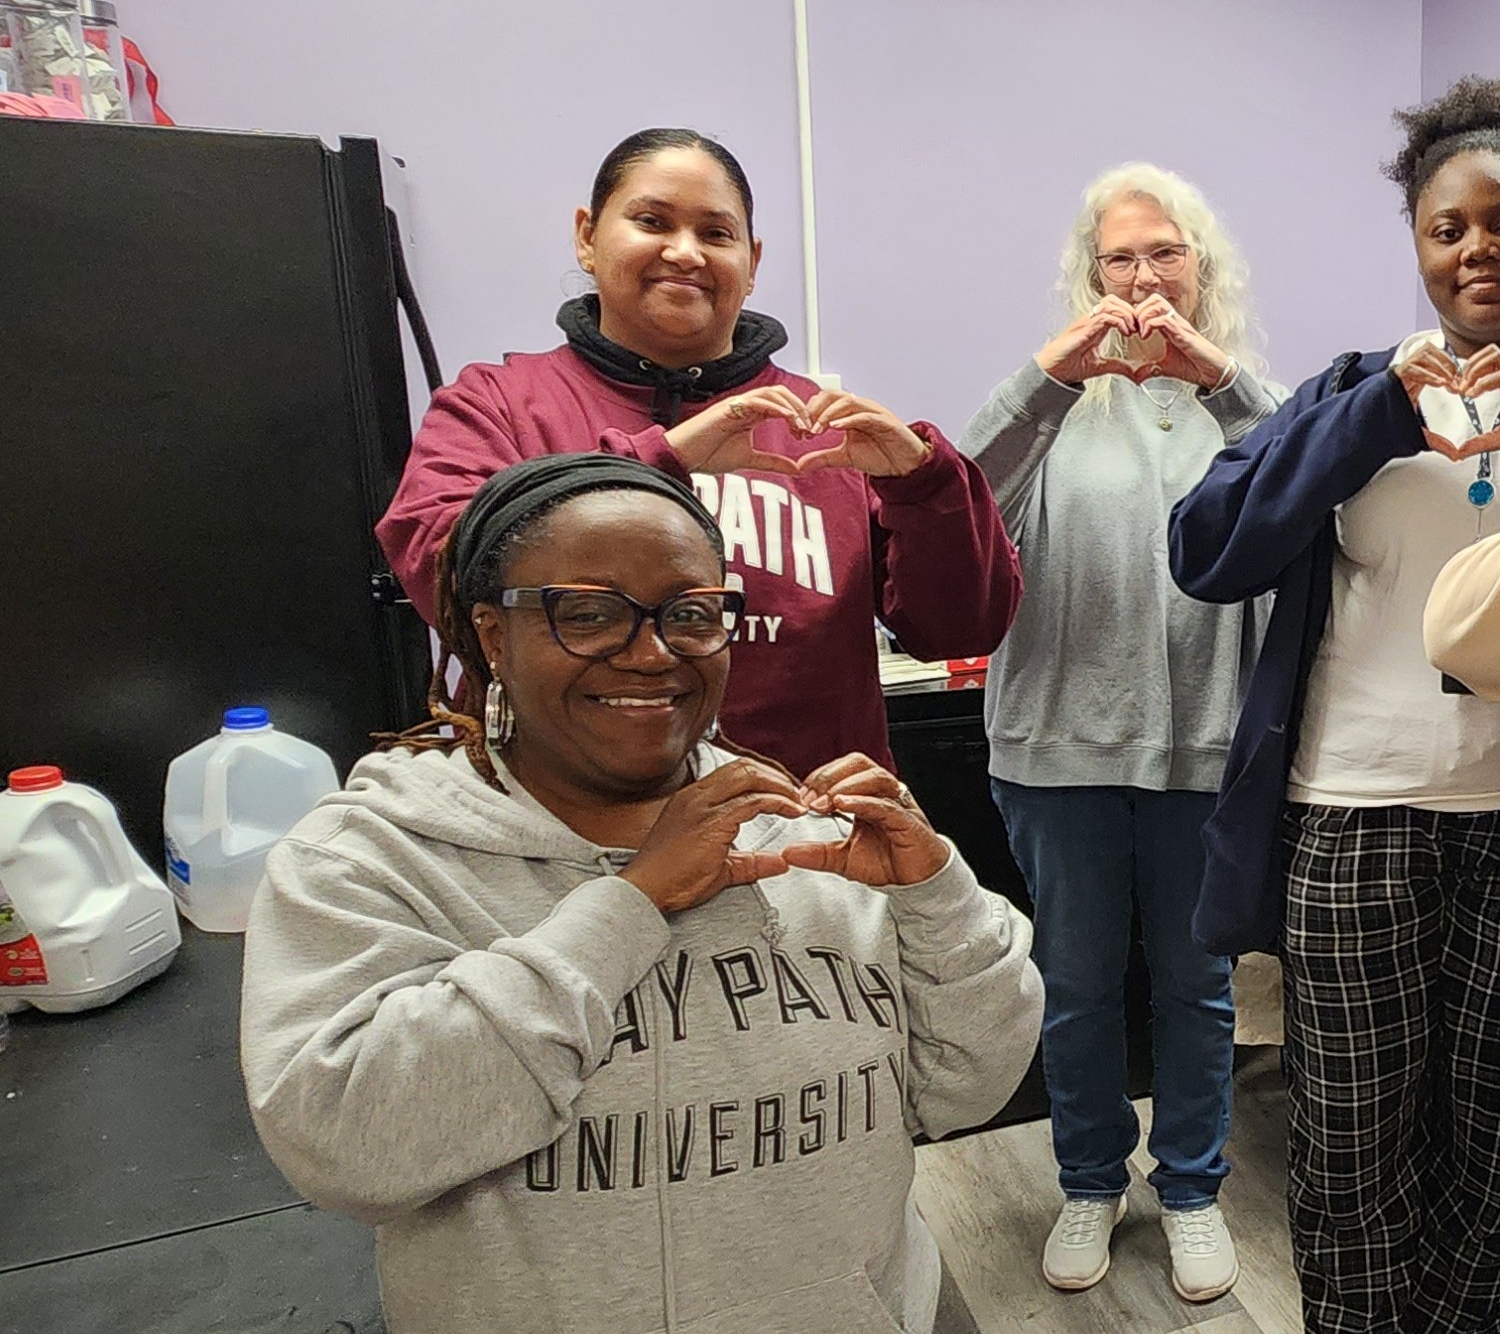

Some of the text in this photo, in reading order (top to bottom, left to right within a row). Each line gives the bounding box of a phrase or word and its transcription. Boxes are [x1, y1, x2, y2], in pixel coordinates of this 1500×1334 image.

[733, 616, 783, 642] TY
[597, 945, 902, 1069] AY PATH
[526, 1047, 905, 1192] UNIVERSITY
